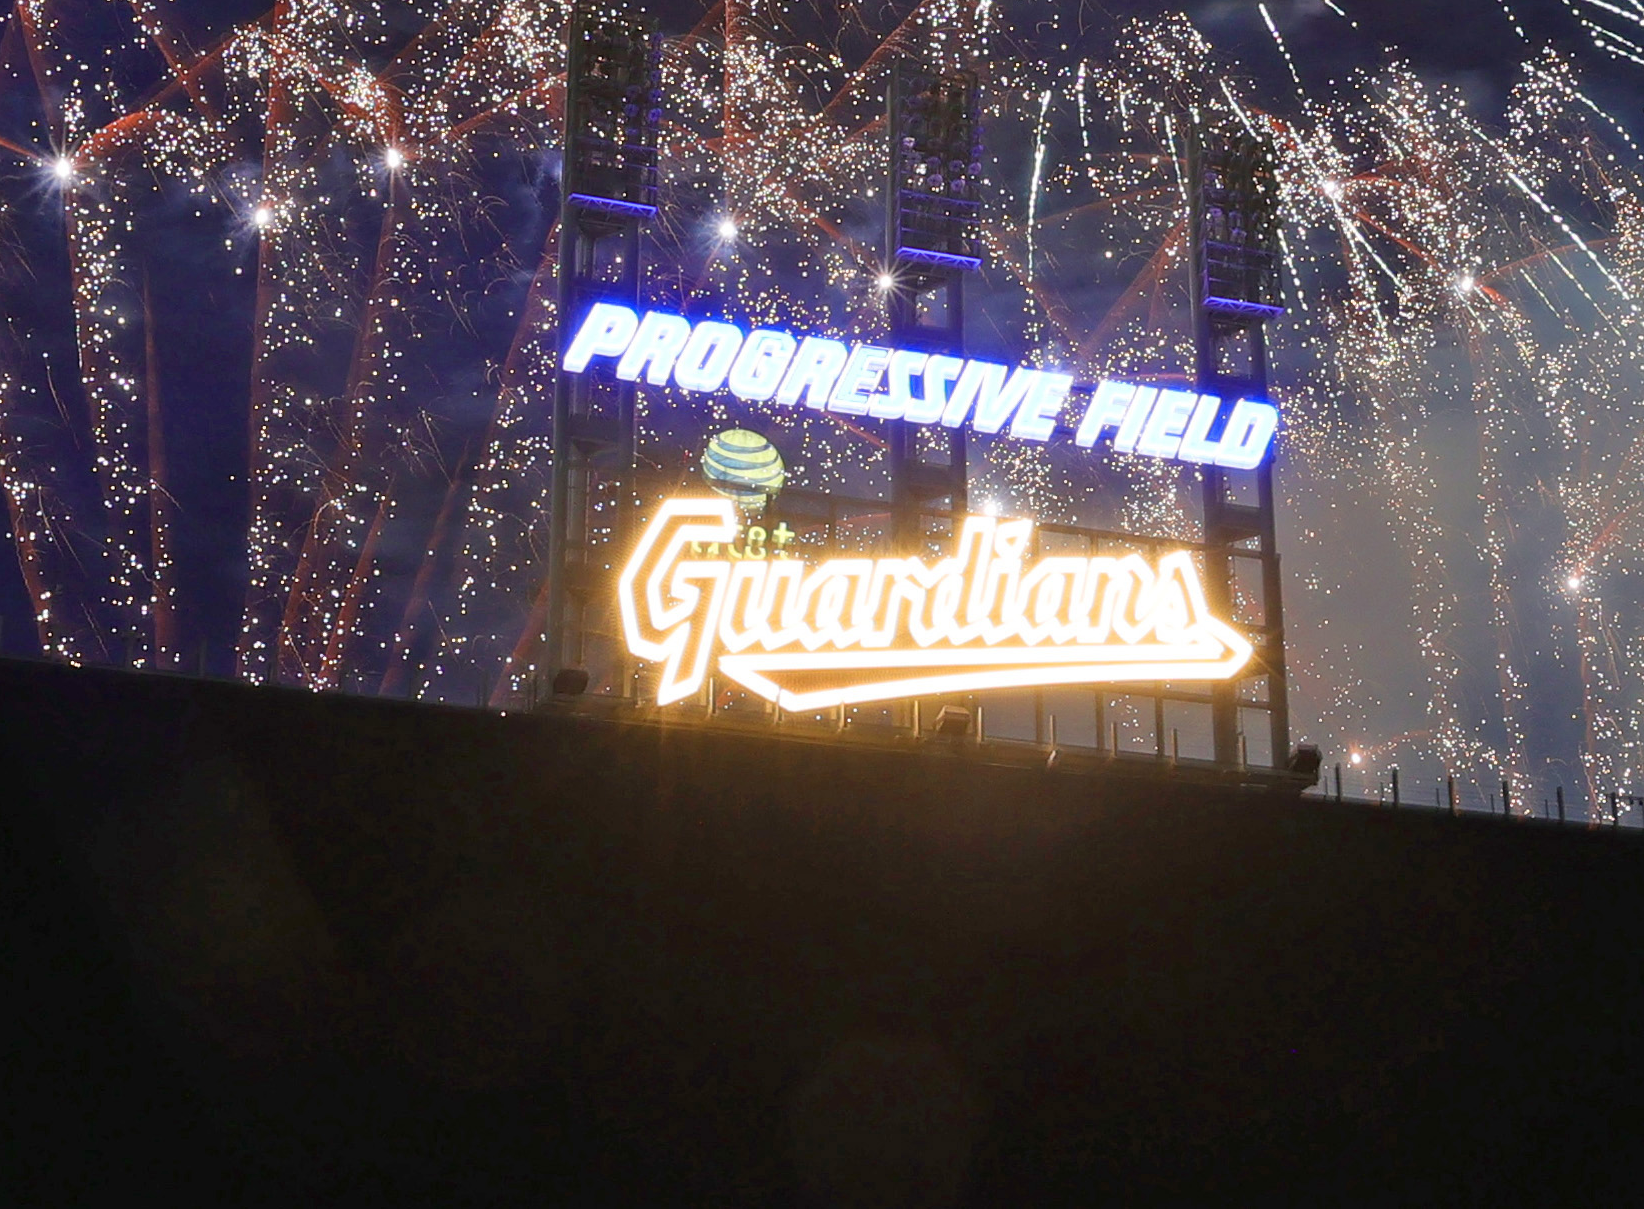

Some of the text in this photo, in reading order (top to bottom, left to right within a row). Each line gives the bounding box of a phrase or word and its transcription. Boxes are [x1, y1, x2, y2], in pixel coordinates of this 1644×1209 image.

[563, 302, 1279, 470] PROGRESSIVE FIELD
[619, 497, 1251, 711] Guardians
